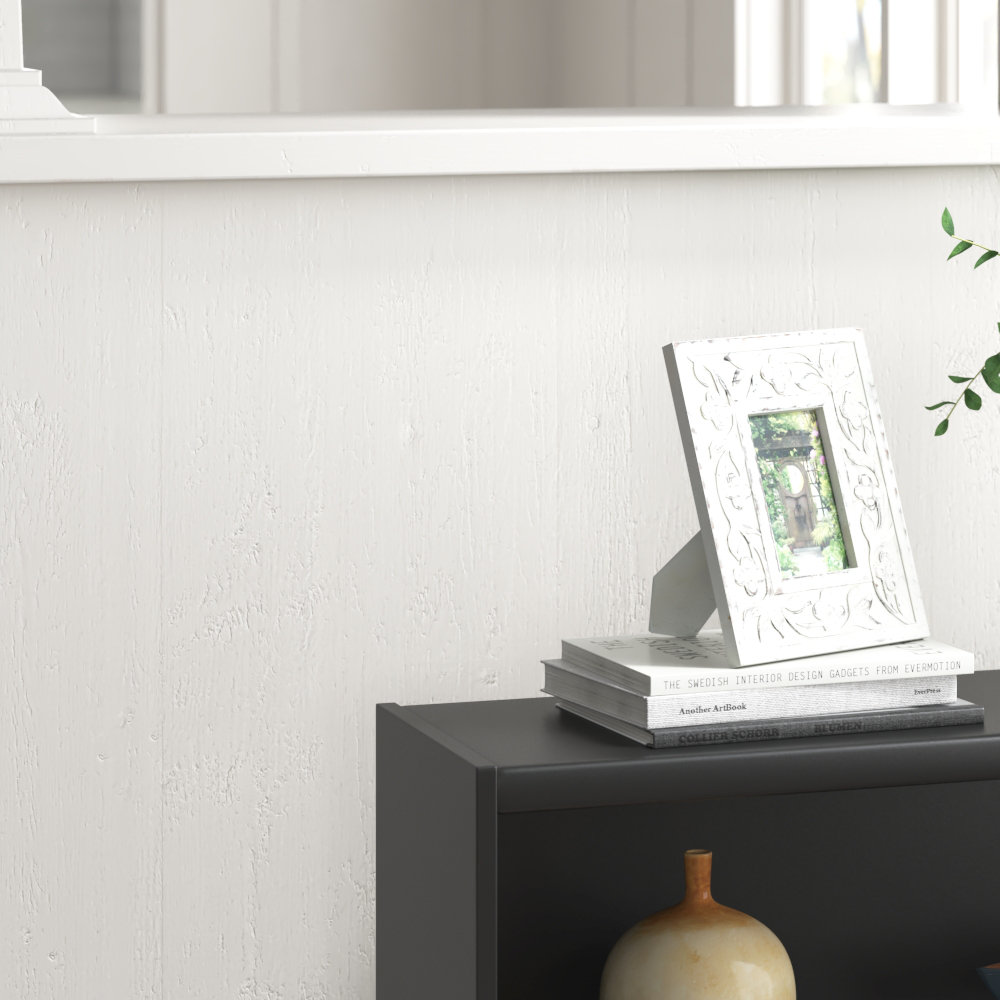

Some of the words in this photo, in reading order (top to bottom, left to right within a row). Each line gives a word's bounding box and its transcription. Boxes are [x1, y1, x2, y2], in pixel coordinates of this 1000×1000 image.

[664, 680, 681, 690] THE
[687, 676, 729, 688] SWEDISH
[735, 672, 783, 685] INTERIOR
[788, 670, 823, 681] DESIGN
[829, 666, 870, 678] GADGETS
[876, 665, 899, 675] FROM
[904, 660, 961, 673] EVERMOTION
[679, 705, 711, 715] Another
[712, 702, 747, 713] ArtBook
